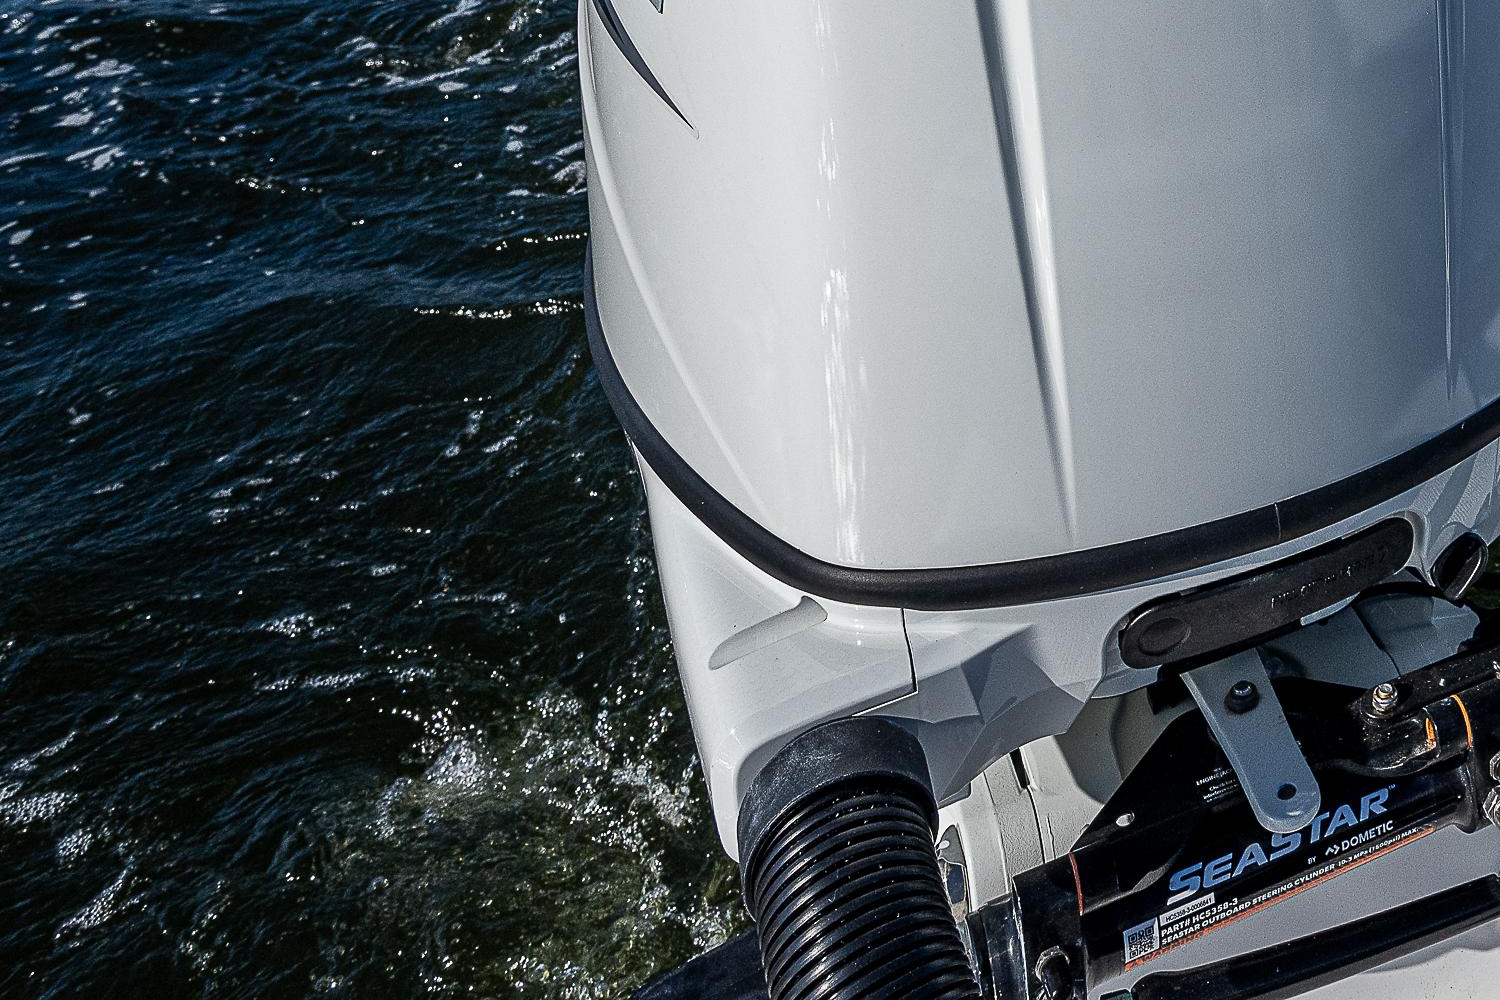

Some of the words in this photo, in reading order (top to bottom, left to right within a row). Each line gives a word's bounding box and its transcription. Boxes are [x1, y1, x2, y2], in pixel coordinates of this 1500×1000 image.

[1166, 787, 1389, 906] SEASTAR
[1341, 820, 1394, 851] DOMETIC
[1307, 855, 1317, 865] BY
[1160, 924, 1201, 945] SEASTAR
[1201, 900, 1252, 927] OUTBOARD
[1252, 882, 1294, 906] STEERING
[1294, 862, 1336, 887] CYLINDER
[1160, 918, 1191, 938] PART#
[1191, 897, 1239, 925] HC5358-3
